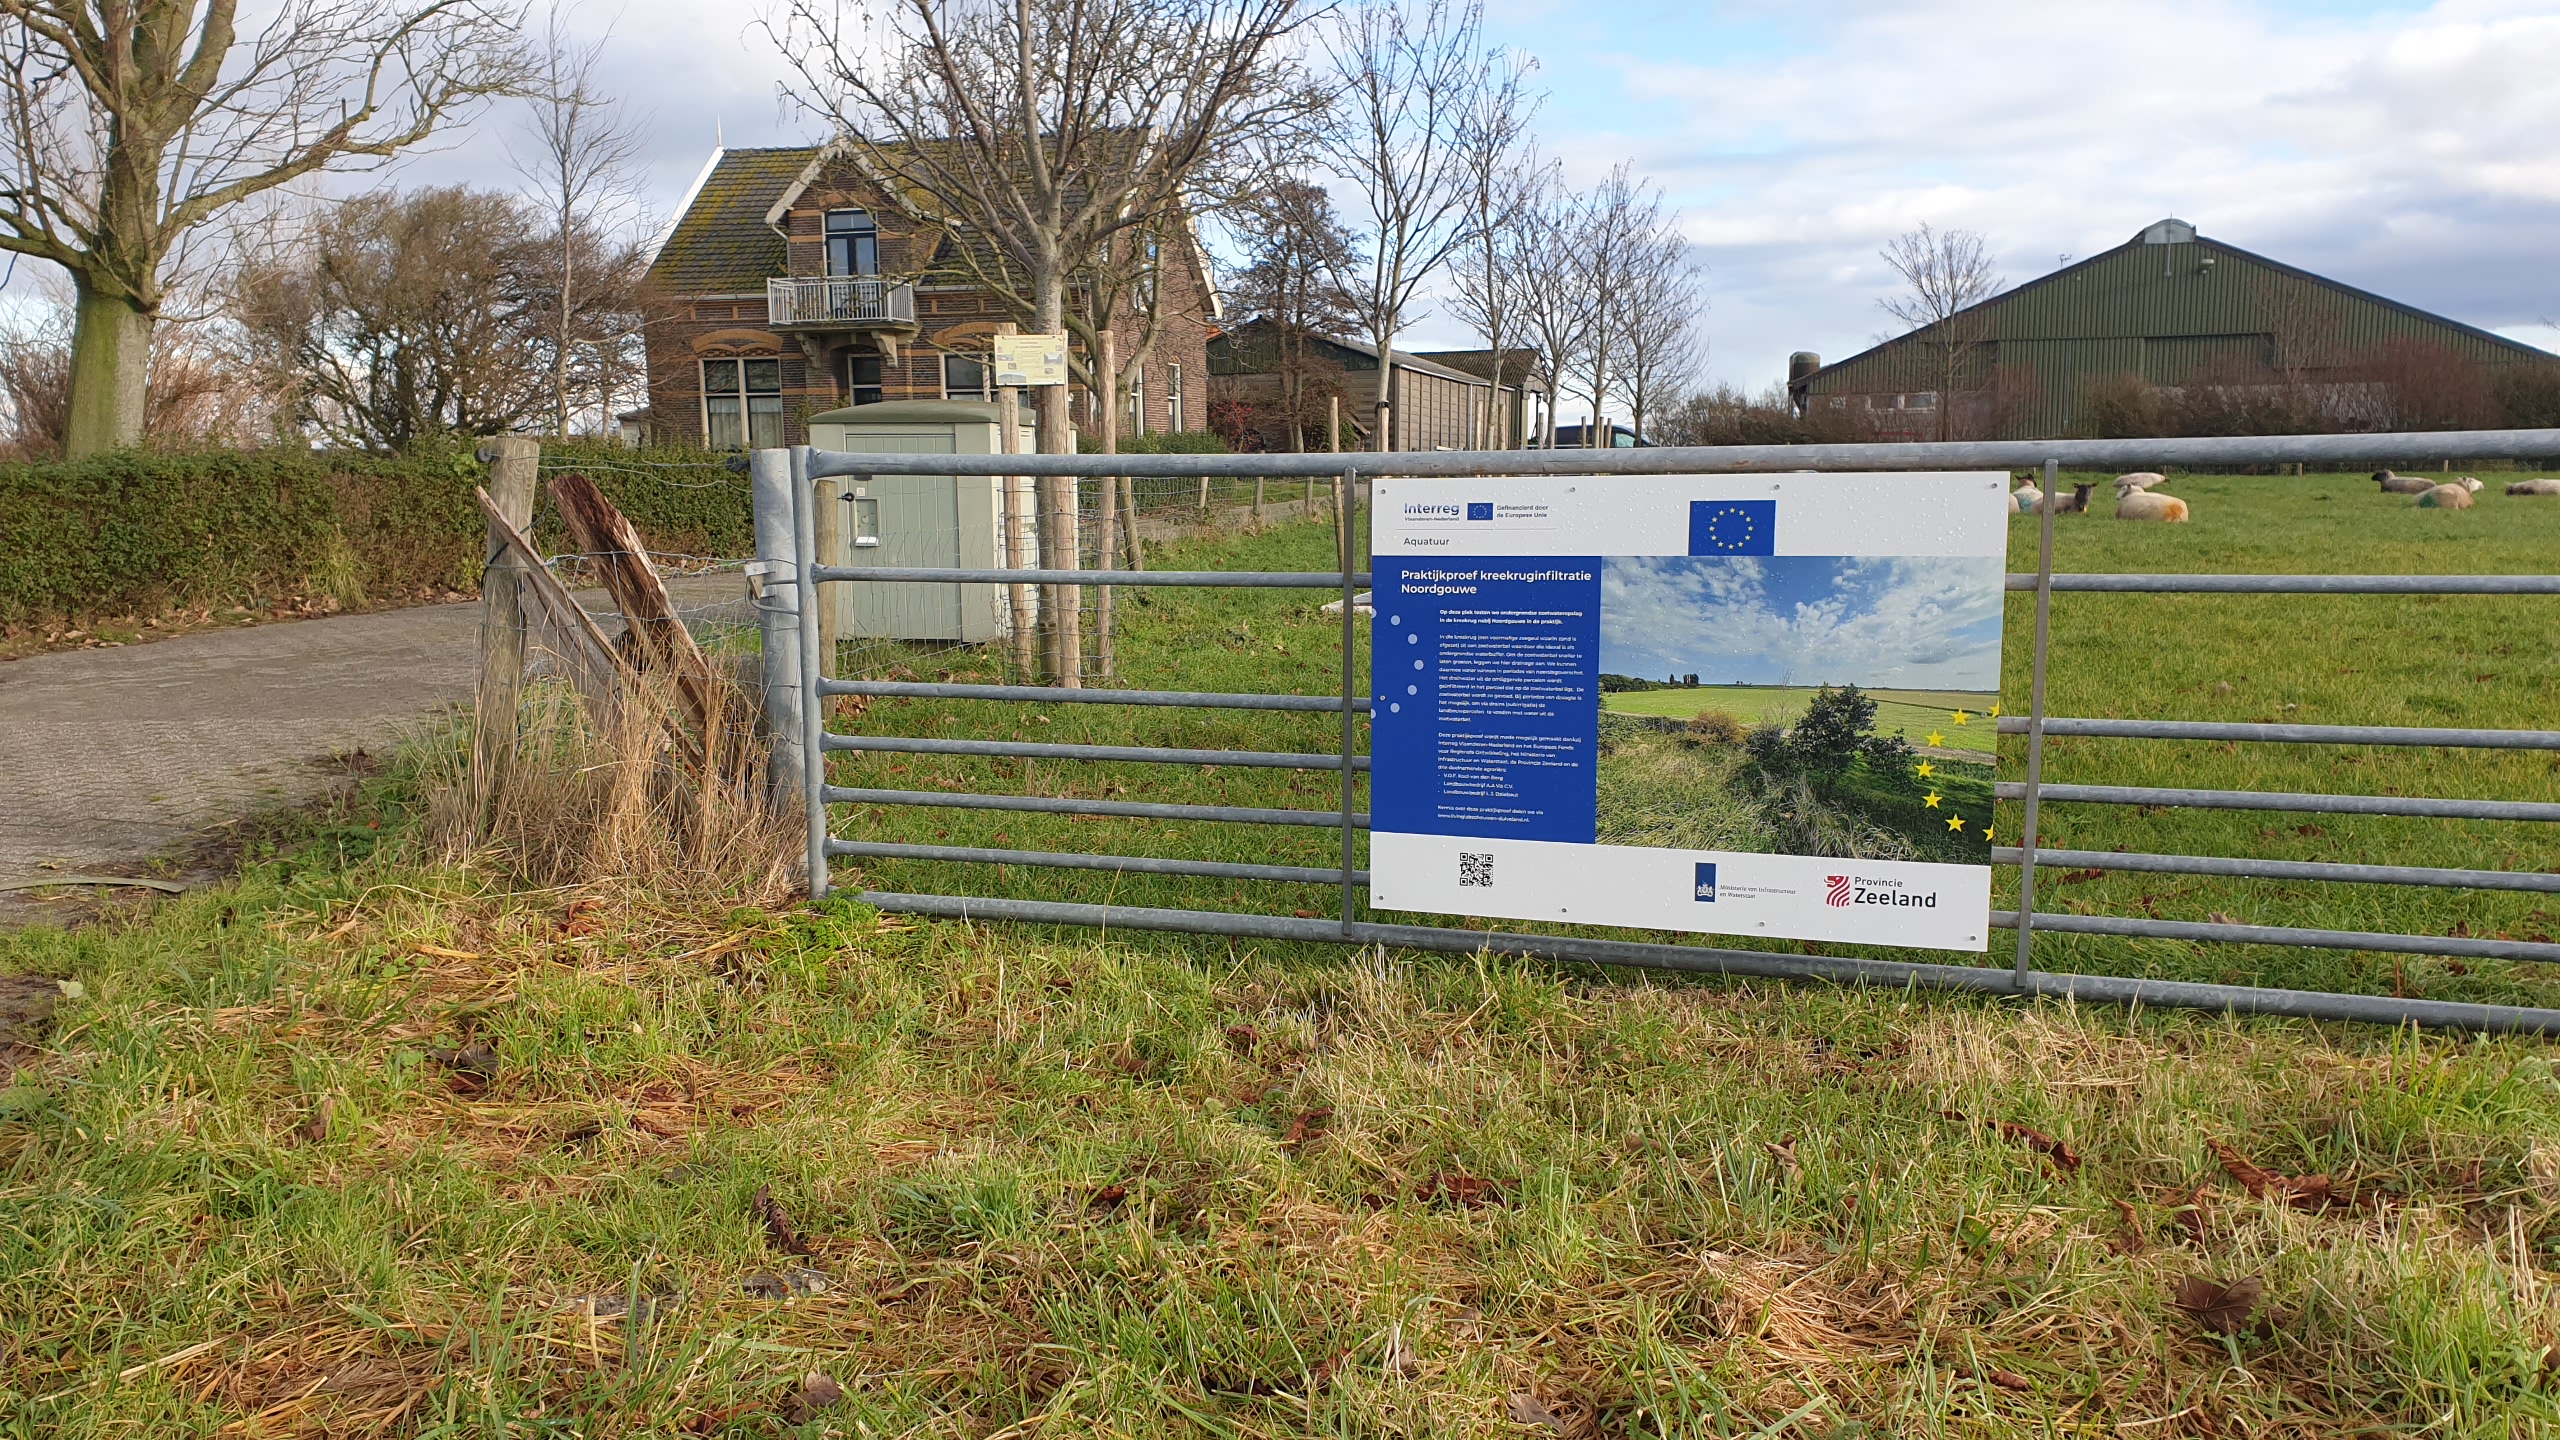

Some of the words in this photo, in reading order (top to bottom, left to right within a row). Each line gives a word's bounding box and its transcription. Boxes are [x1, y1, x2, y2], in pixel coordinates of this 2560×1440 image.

[1404, 503, 1460, 516] Interreg
[1403, 537, 1450, 547] Aquatuur
[1401, 570, 1478, 582] Praktijkproef
[1480, 570, 1592, 583] kreekruginfiltratie
[1401, 584, 1477, 596] Noordgouwe
[1719, 884, 1747, 892] Ministerie
[1854, 876, 1904, 888] Provincie
[1854, 887, 1937, 908] Zeeland
